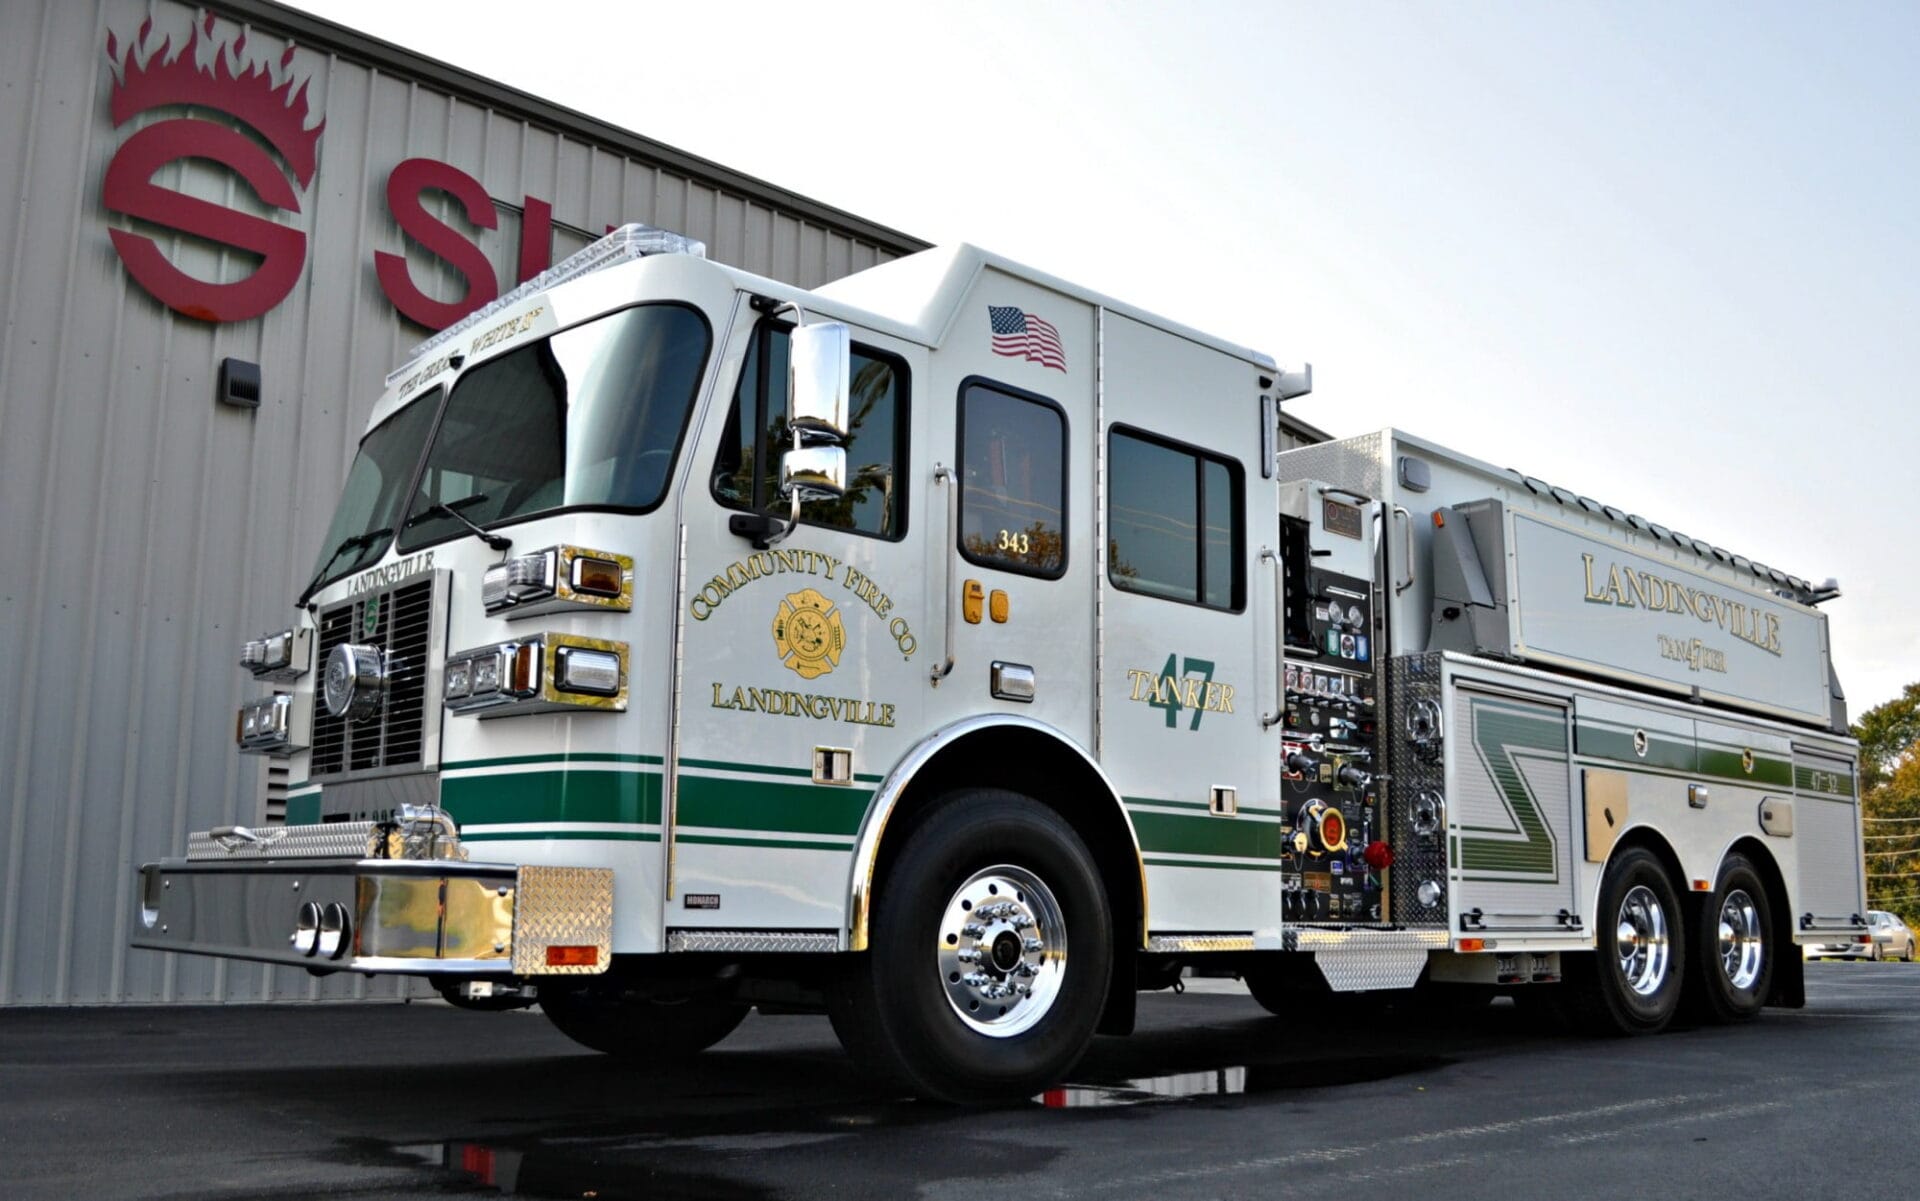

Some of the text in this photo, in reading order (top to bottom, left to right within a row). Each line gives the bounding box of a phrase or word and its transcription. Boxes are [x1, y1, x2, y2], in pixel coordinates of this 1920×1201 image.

[999, 529, 1028, 554] 343
[347, 550, 435, 597] LANDINGVILLE
[690, 549, 917, 661] COMMUNITY FIRE CO.
[1582, 553, 1784, 657] LANDINGVILLE
[712, 683, 895, 727] LANDINGVILLE
[1127, 668, 1236, 714] TANKER
[1149, 653, 1215, 731] 47
